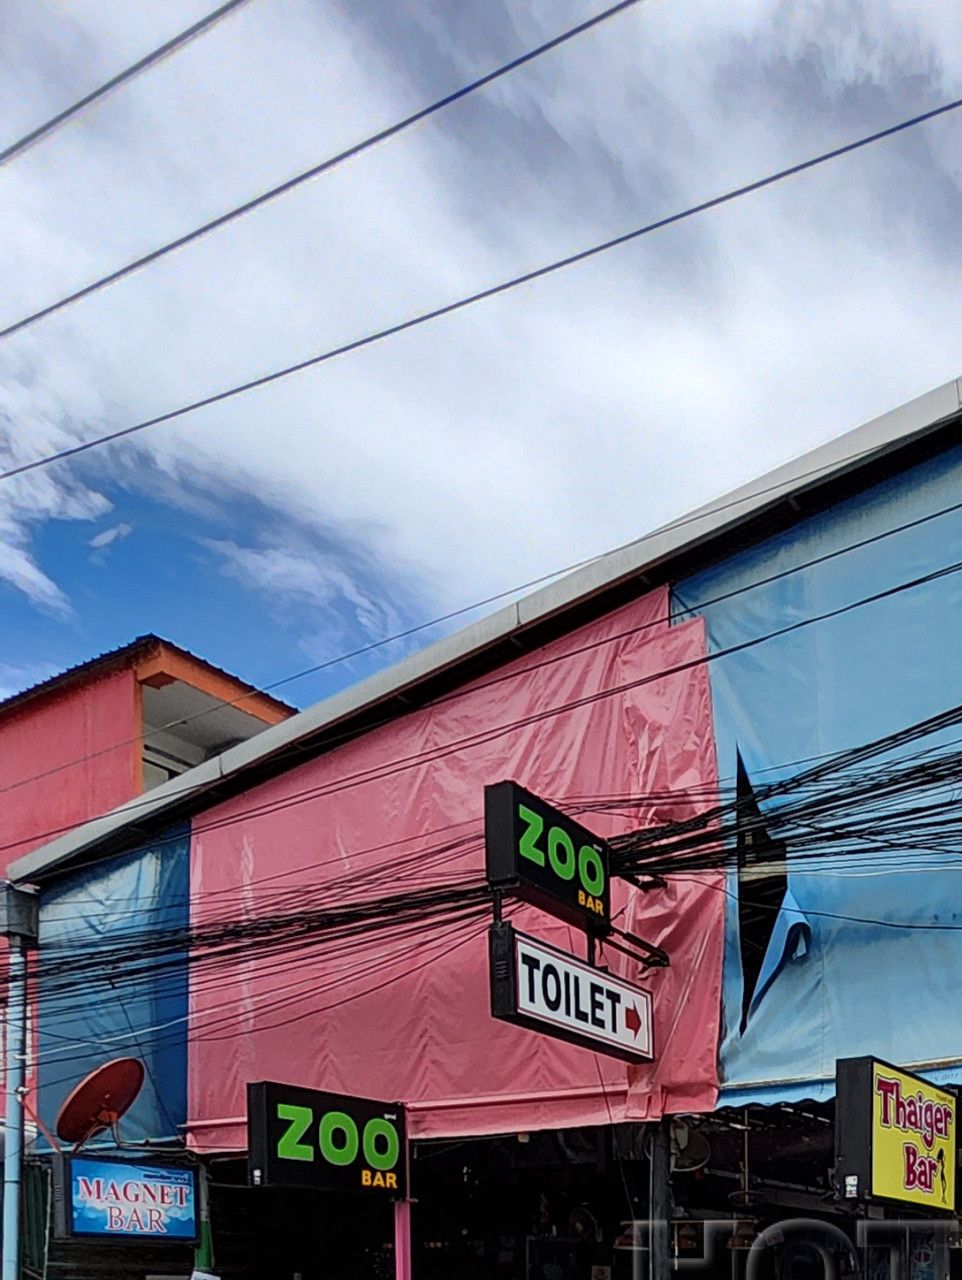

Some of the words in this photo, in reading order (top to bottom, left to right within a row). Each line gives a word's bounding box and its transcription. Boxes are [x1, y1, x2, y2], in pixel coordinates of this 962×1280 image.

[519, 804, 604, 896] ZOO
[578, 889, 604, 915] BAR
[521, 952, 621, 1034] TOILET
[277, 1104, 400, 1170] ZOO
[876, 1074, 953, 1151] Thaiger
[78, 1176, 190, 1206] MAGNET
[361, 1169, 398, 1189] BAR
[903, 1142, 940, 1192] Bar
[107, 1206, 166, 1233] BAR
